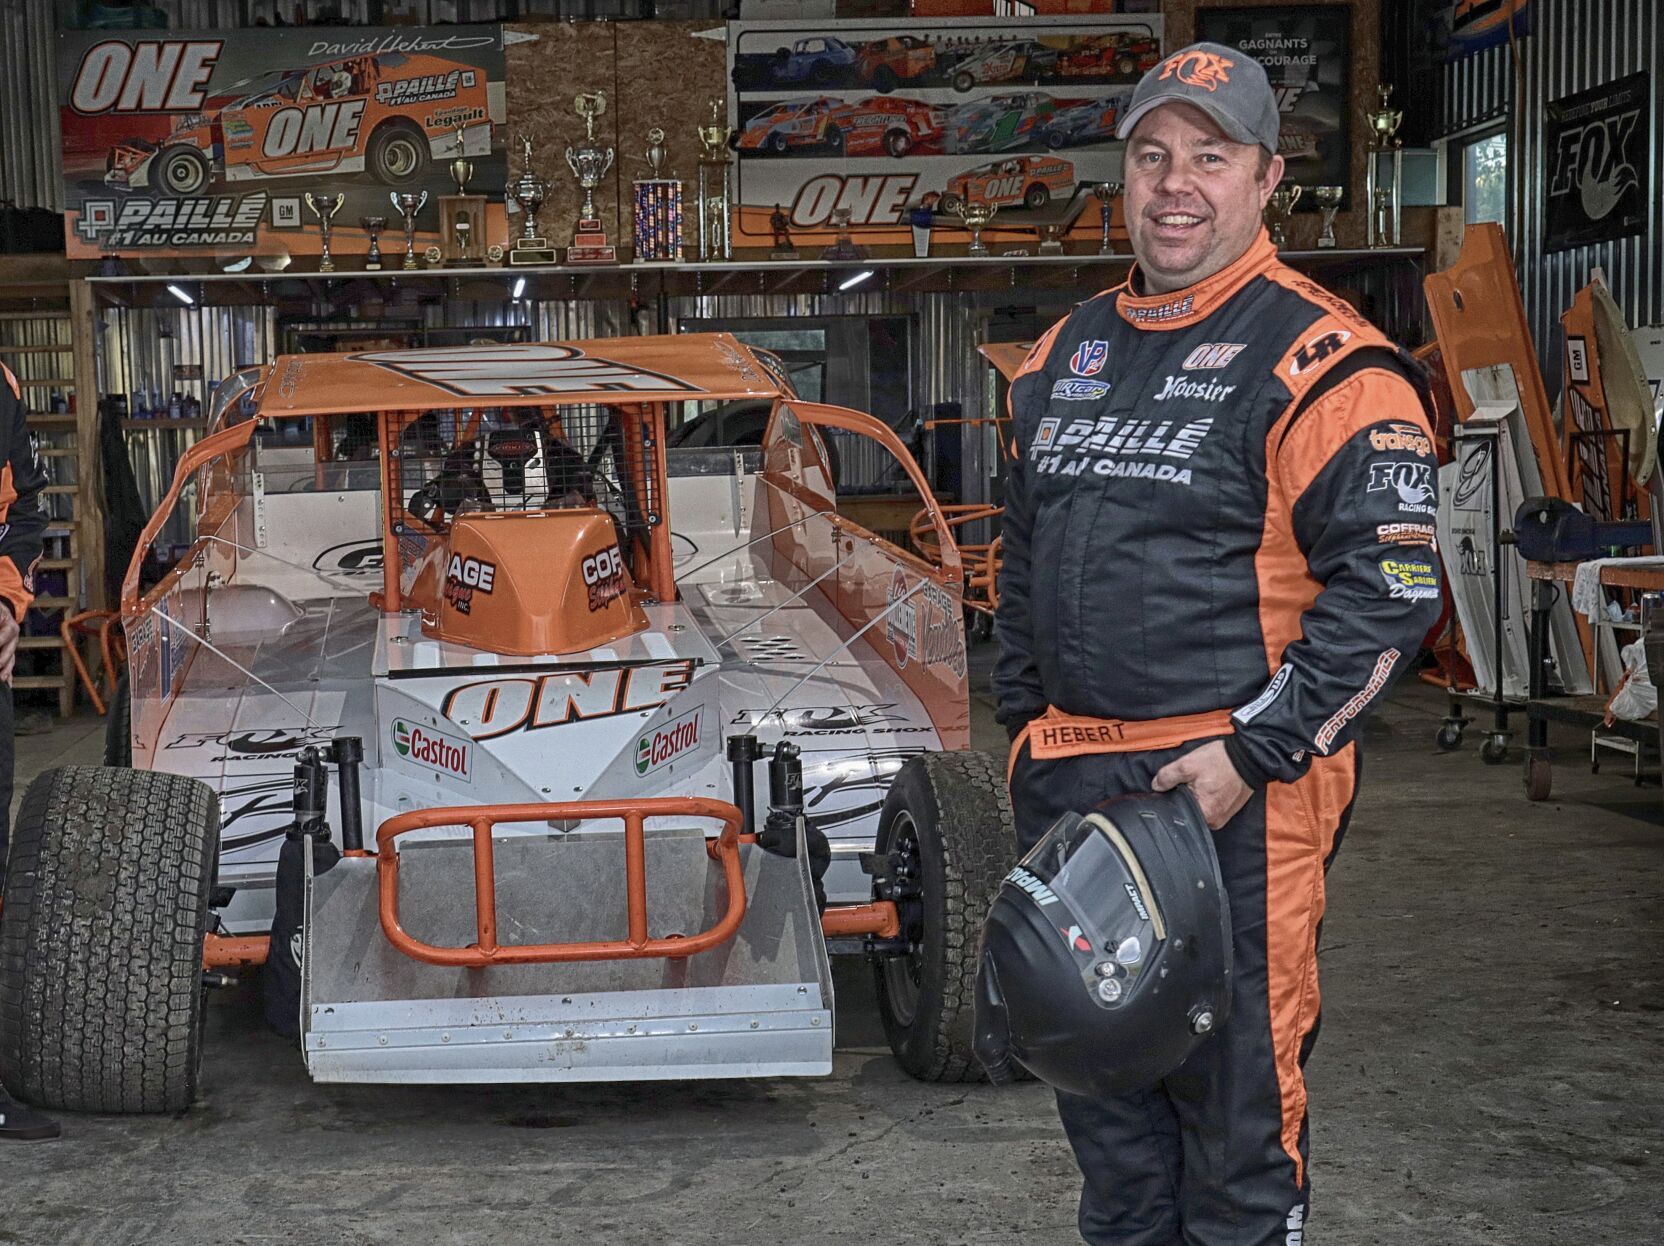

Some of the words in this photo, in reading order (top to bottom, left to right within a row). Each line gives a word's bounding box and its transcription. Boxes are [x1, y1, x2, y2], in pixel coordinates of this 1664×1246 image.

[308, 37, 378, 57] David
[1238, 38, 1308, 50] GAGNANTS
[70, 39, 224, 114] ONE
[262, 98, 368, 158] ONE
[426, 108, 484, 128] Legault
[1551, 109, 1640, 206] FOX
[790, 172, 920, 228] ONE
[983, 176, 1026, 199] ONE
[116, 191, 269, 230] PAILLÉ
[279, 204, 294, 219] GM
[108, 230, 134, 245] #1
[139, 233, 168, 245] AU
[171, 231, 255, 245] CANADA
[1076, 340, 1109, 375] VP
[1182, 342, 1248, 370] ONE
[1572, 349, 1584, 372] GM
[1153, 375, 1237, 402] Hoosier
[1052, 416, 1215, 460] PAILLÉ
[1037, 455, 1062, 473] #1
[1092, 461, 1192, 485] CANADA
[1366, 462, 1433, 498] FOX
[1398, 502, 1427, 513] RACING
[1376, 523, 1435, 535] COFFRAG
[440, 658, 696, 743] ONE
[730, 703, 910, 730] FOX
[164, 725, 345, 754] FOX
[651, 711, 699, 771] Castrol
[783, 728, 867, 738] RACING
[871, 726, 936, 735] SHOX
[1043, 722, 1126, 746] HEBERT
[210, 751, 298, 763] RACING
[409, 727, 468, 776] Castrol
[1006, 866, 1060, 907] IMPAC
[1125, 884, 1149, 920] IMPACT
